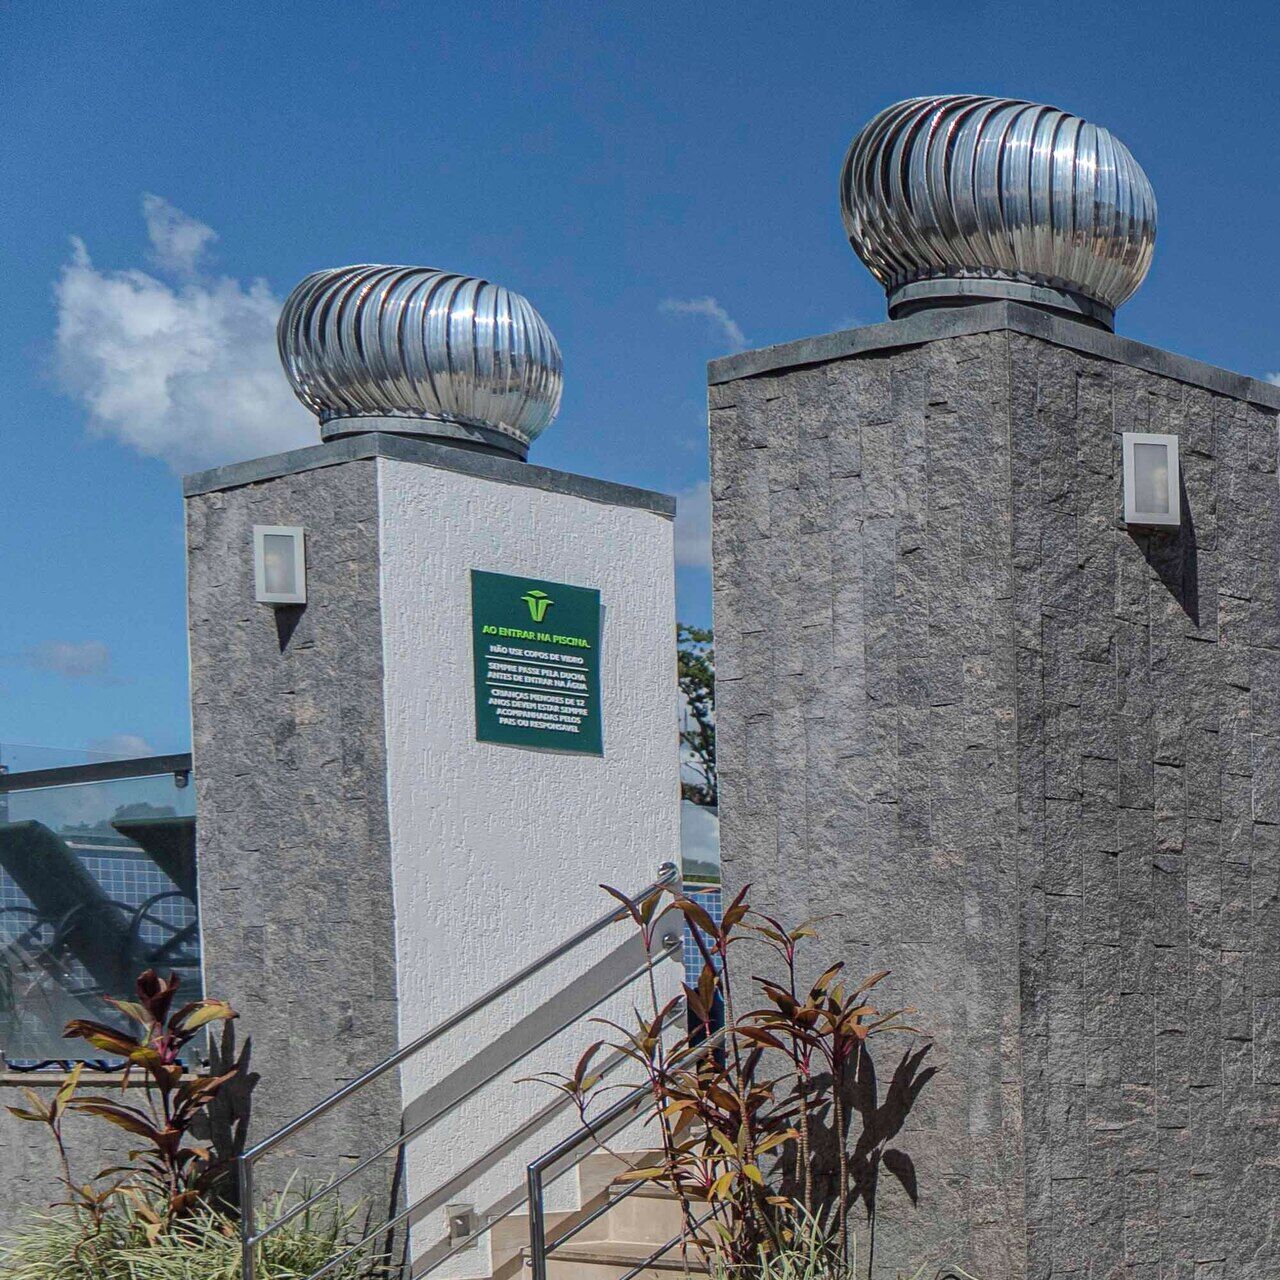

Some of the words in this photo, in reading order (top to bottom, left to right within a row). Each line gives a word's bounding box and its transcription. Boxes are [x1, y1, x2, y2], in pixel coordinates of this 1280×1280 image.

[483, 626, 497, 634] AO
[499, 627, 535, 640] ENTRAR
[537, 633, 551, 642] NA
[490, 644, 507, 654] NÃO
[509, 648, 523, 656] USE
[524, 650, 549, 659] COPOS
[550, 653, 559, 661] DE
[561, 655, 584, 664] VIDRO
[488, 662, 518, 672] SEMPRE
[518, 666, 541, 675] PASSE
[541, 669, 559, 678] PELA
[560, 672, 586, 681] DUCHA
[487, 671, 512, 680] ANTES
[513, 674, 523, 682] DE
[525, 676, 553, 686] ENTRAR
[565, 680, 587, 690] ÁGUA
[491, 689, 528, 700] CRIANÇAS
[530, 693, 564, 704] MENORES
[565, 697, 575, 705] DE
[488, 698, 511, 706] ANOS
[512, 701, 536, 710] DEVEM
[538, 703, 560, 713] ESTAR
[561, 706, 588, 716] SEMPRE
[496, 708, 559, 721] ACOMPANHADAS
[560, 714, 581, 724] PELOS
[499, 717, 516, 725] PAIS
[517, 719, 528, 727] OU
